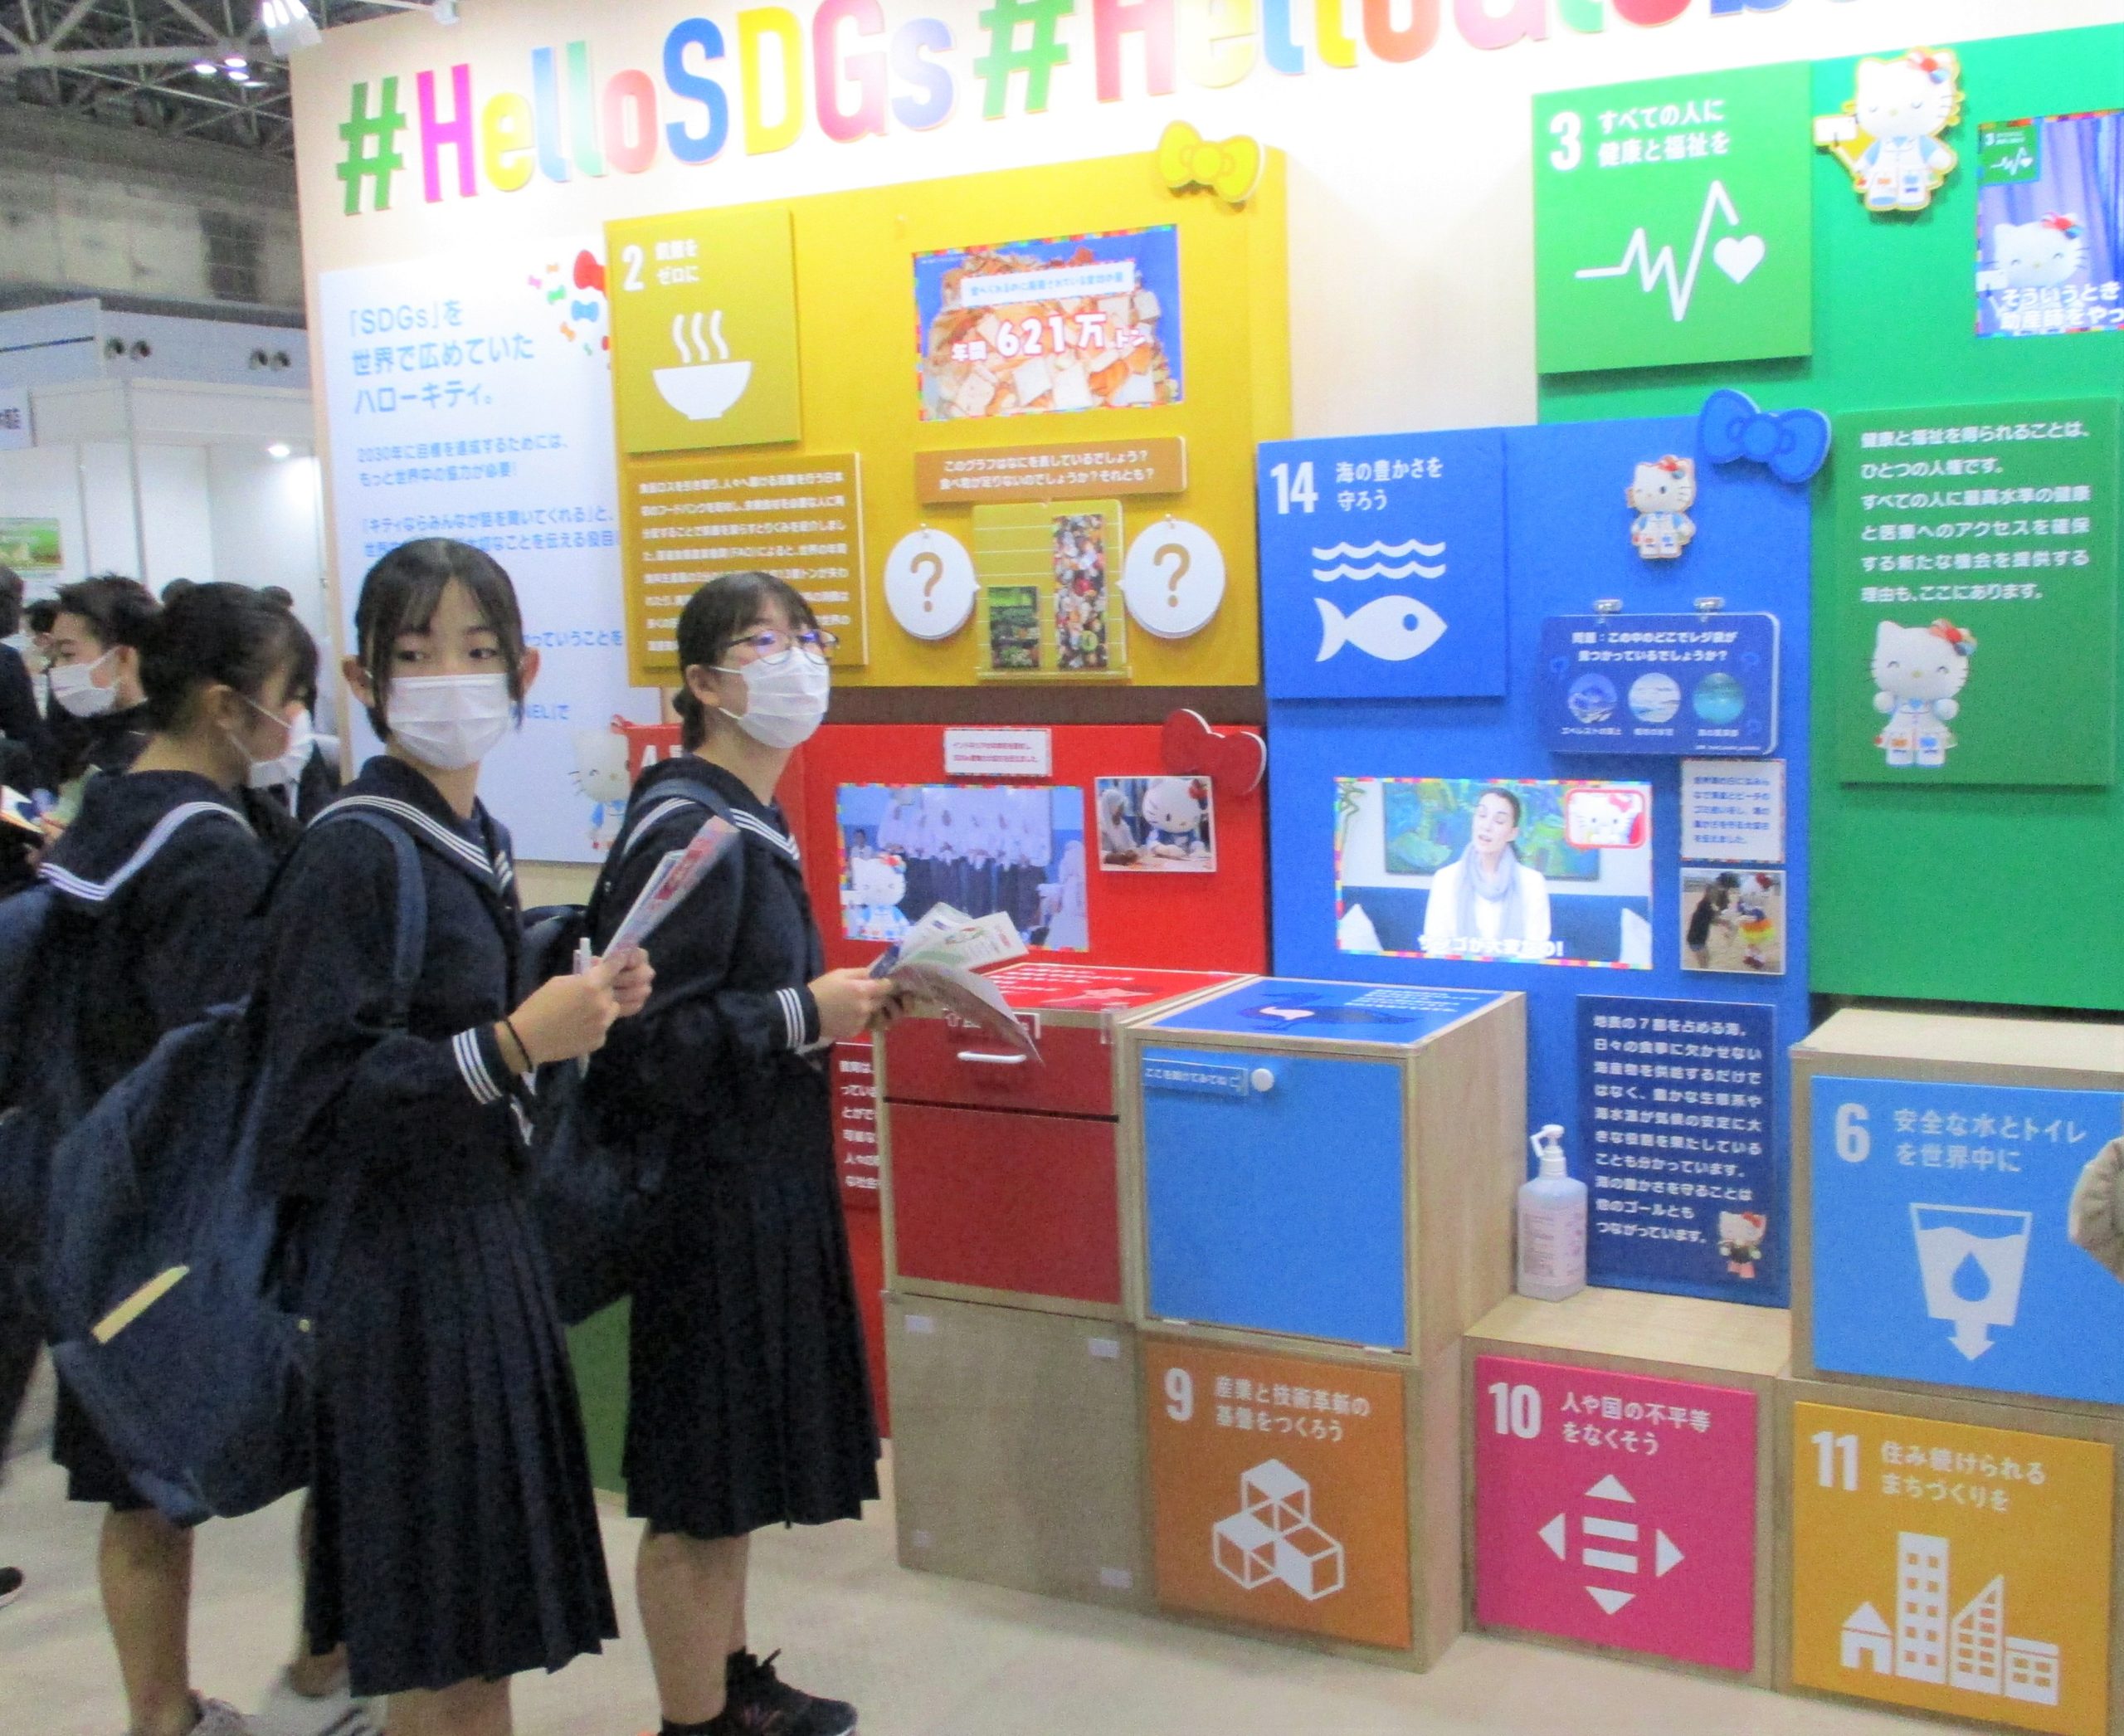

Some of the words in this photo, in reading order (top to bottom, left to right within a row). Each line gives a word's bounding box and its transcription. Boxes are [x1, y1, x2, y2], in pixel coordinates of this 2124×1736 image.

[1598, 99, 1726, 134] すべての人に
[1549, 111, 1582, 171] 3
[1598, 130, 1731, 168] 健康と福祉を
[622, 245, 645, 291] 2
[349, 300, 463, 337] 「SDGs」を
[352, 333, 535, 376] 世界で広めていた
[354, 380, 493, 414] ハローキティ。
[1270, 461, 1319, 514] 14
[1336, 456, 1444, 483] 海の豊かさを
[1337, 489, 1388, 511] 守ろう
[1594, 1038, 1762, 1061] 日々の食事に欠かせない
[1834, 1102, 1871, 1163] 6
[1893, 1108, 2087, 1144] 安全な水とトイレ
[1897, 1143, 2022, 1173] を世界中に
[1164, 1367, 1194, 1422] 9
[1488, 1382, 1542, 1439] 10
[1560, 1391, 1711, 1433] 人や国の不平等
[1562, 1421, 1659, 1456] をなくそう
[1811, 1431, 1858, 1491] 11
[1881, 1440, 2047, 1485] 住み続けられる
[1882, 1472, 2010, 1514] まちづくりを
